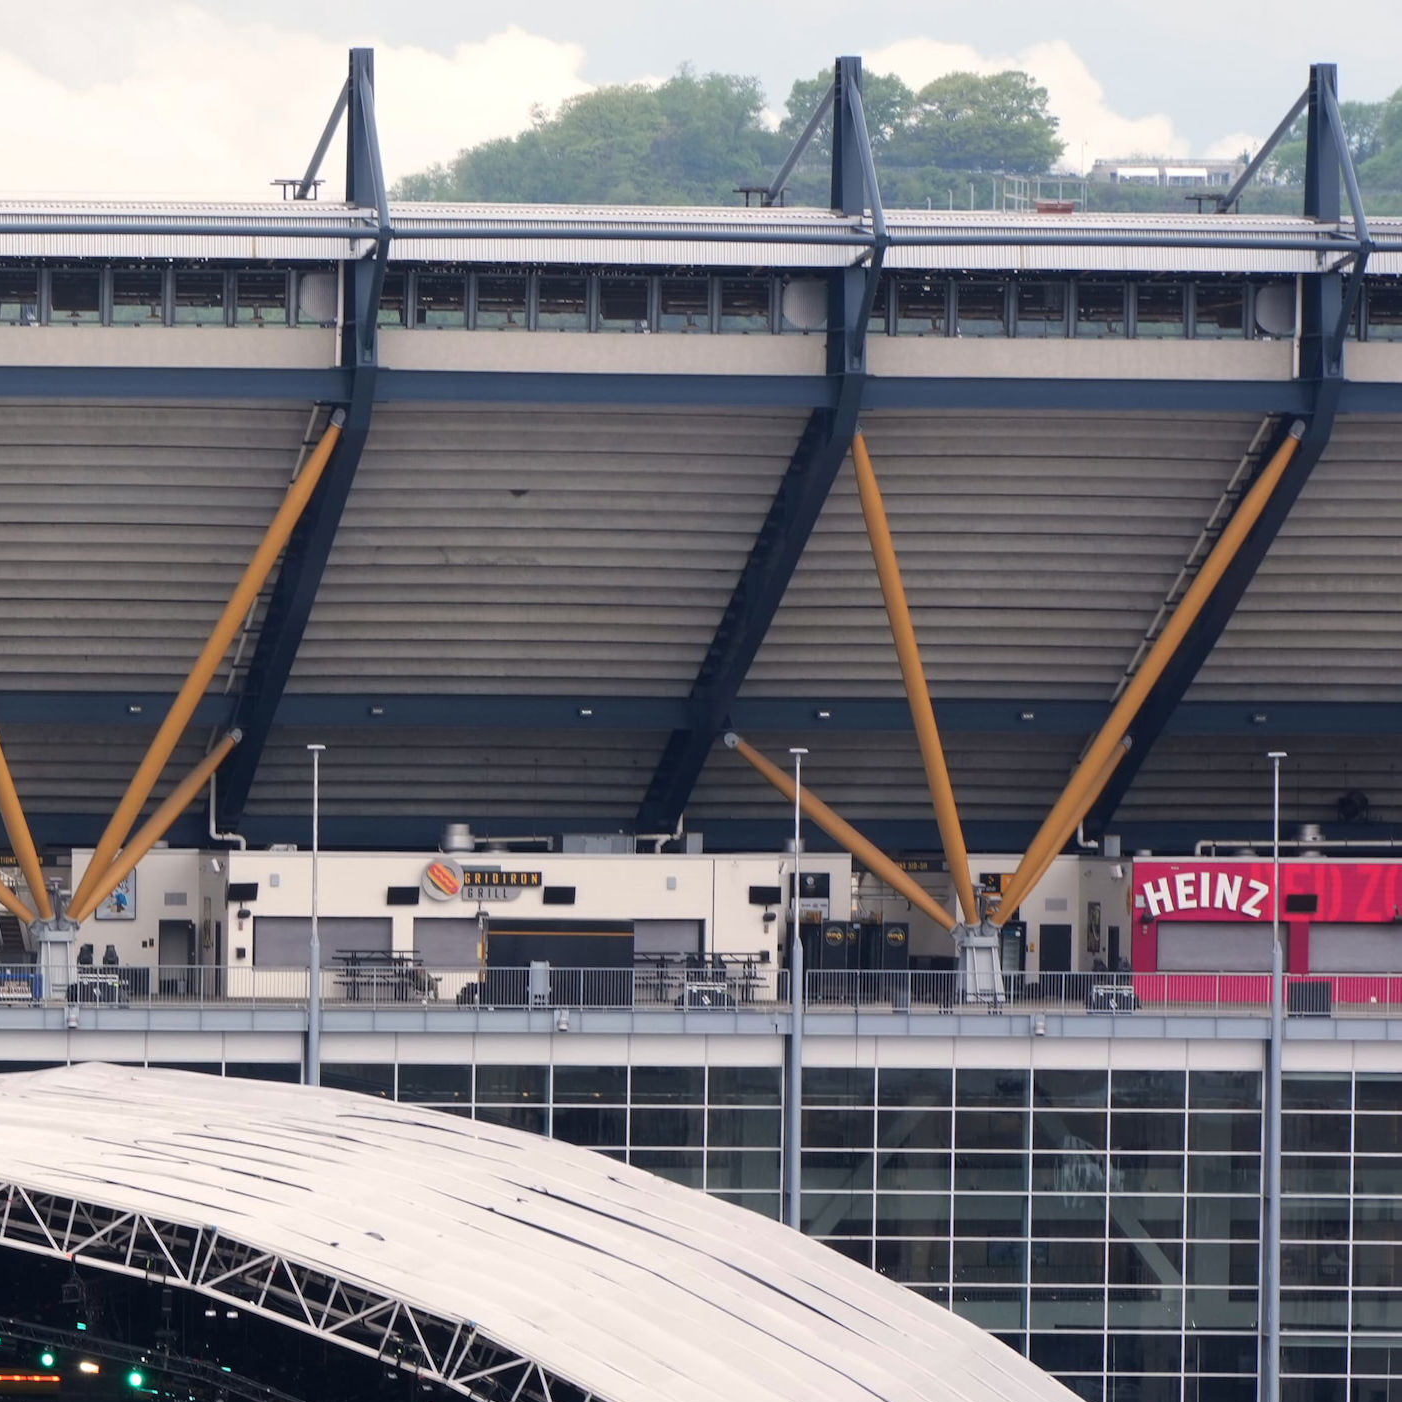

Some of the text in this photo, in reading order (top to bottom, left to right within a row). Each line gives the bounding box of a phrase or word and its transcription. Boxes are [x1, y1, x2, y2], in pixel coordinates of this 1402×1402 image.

[464, 872, 538, 884] GRIDIRON
[468, 888, 507, 899] GRILL
[1143, 872, 1269, 918] HEINZ
